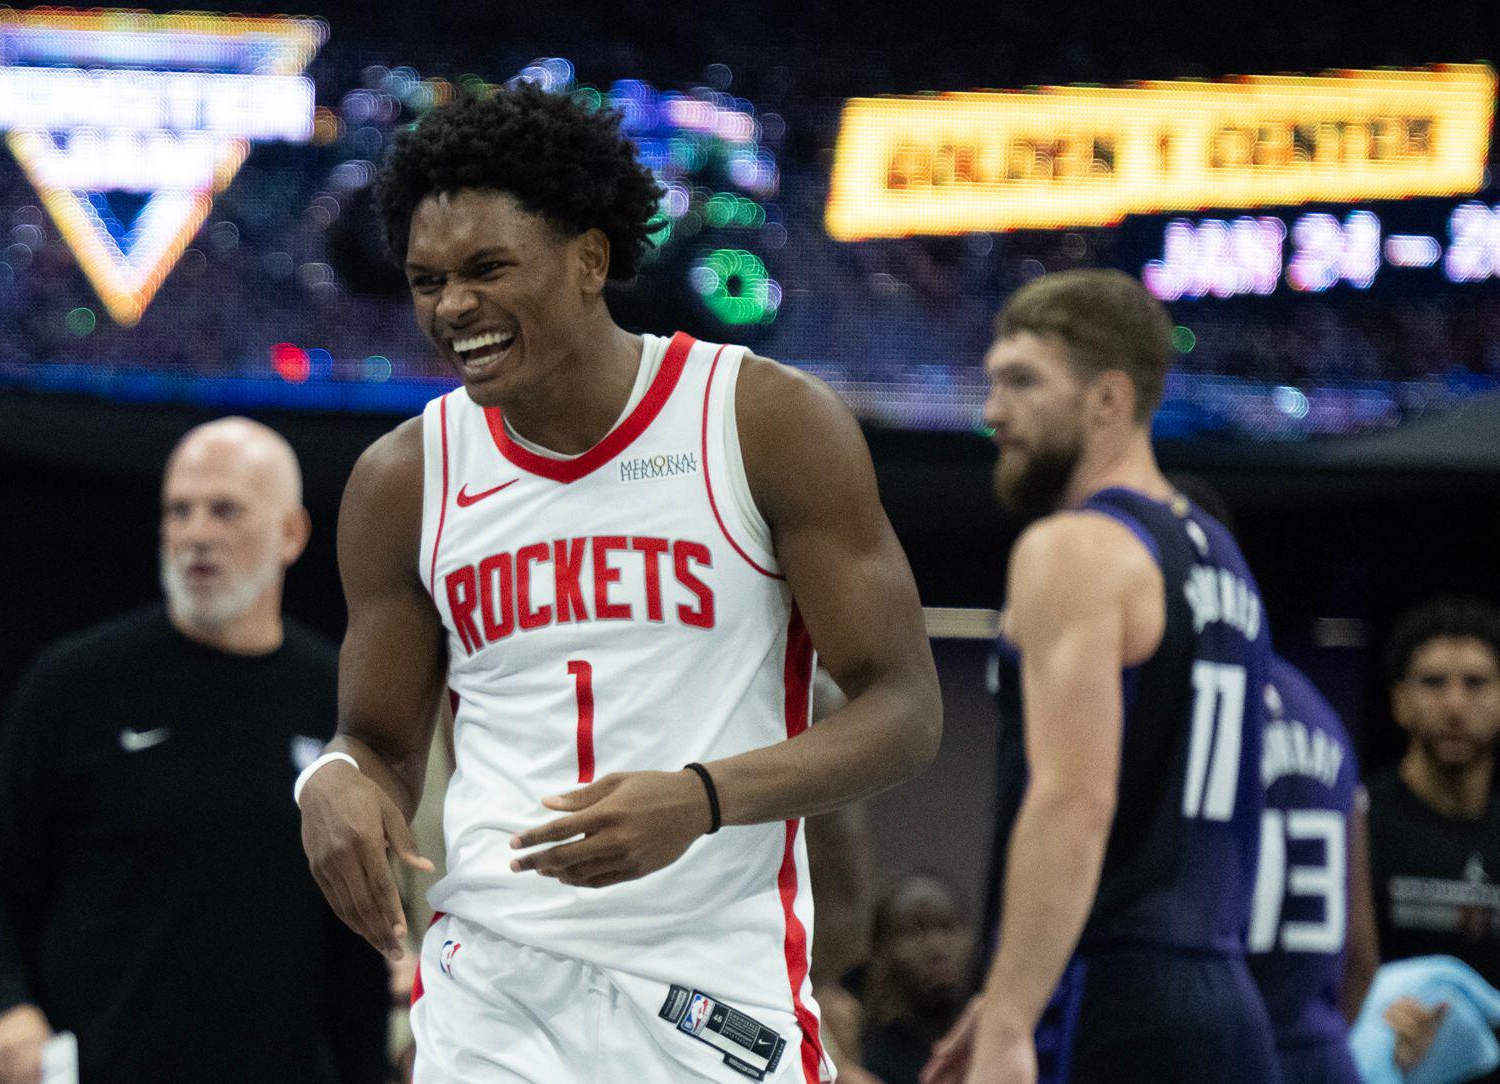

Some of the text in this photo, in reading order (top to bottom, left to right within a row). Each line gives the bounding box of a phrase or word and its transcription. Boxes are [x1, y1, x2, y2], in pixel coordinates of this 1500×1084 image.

[1209, 116, 1436, 169] CENTER
[620, 452, 697, 472] MEMORIAL
[620, 461, 697, 481] HERMANN
[443, 534, 716, 657] ROCKETS
[566, 659, 596, 784] 1
[1181, 659, 1247, 822] 11
[1247, 807, 1347, 954] 13
